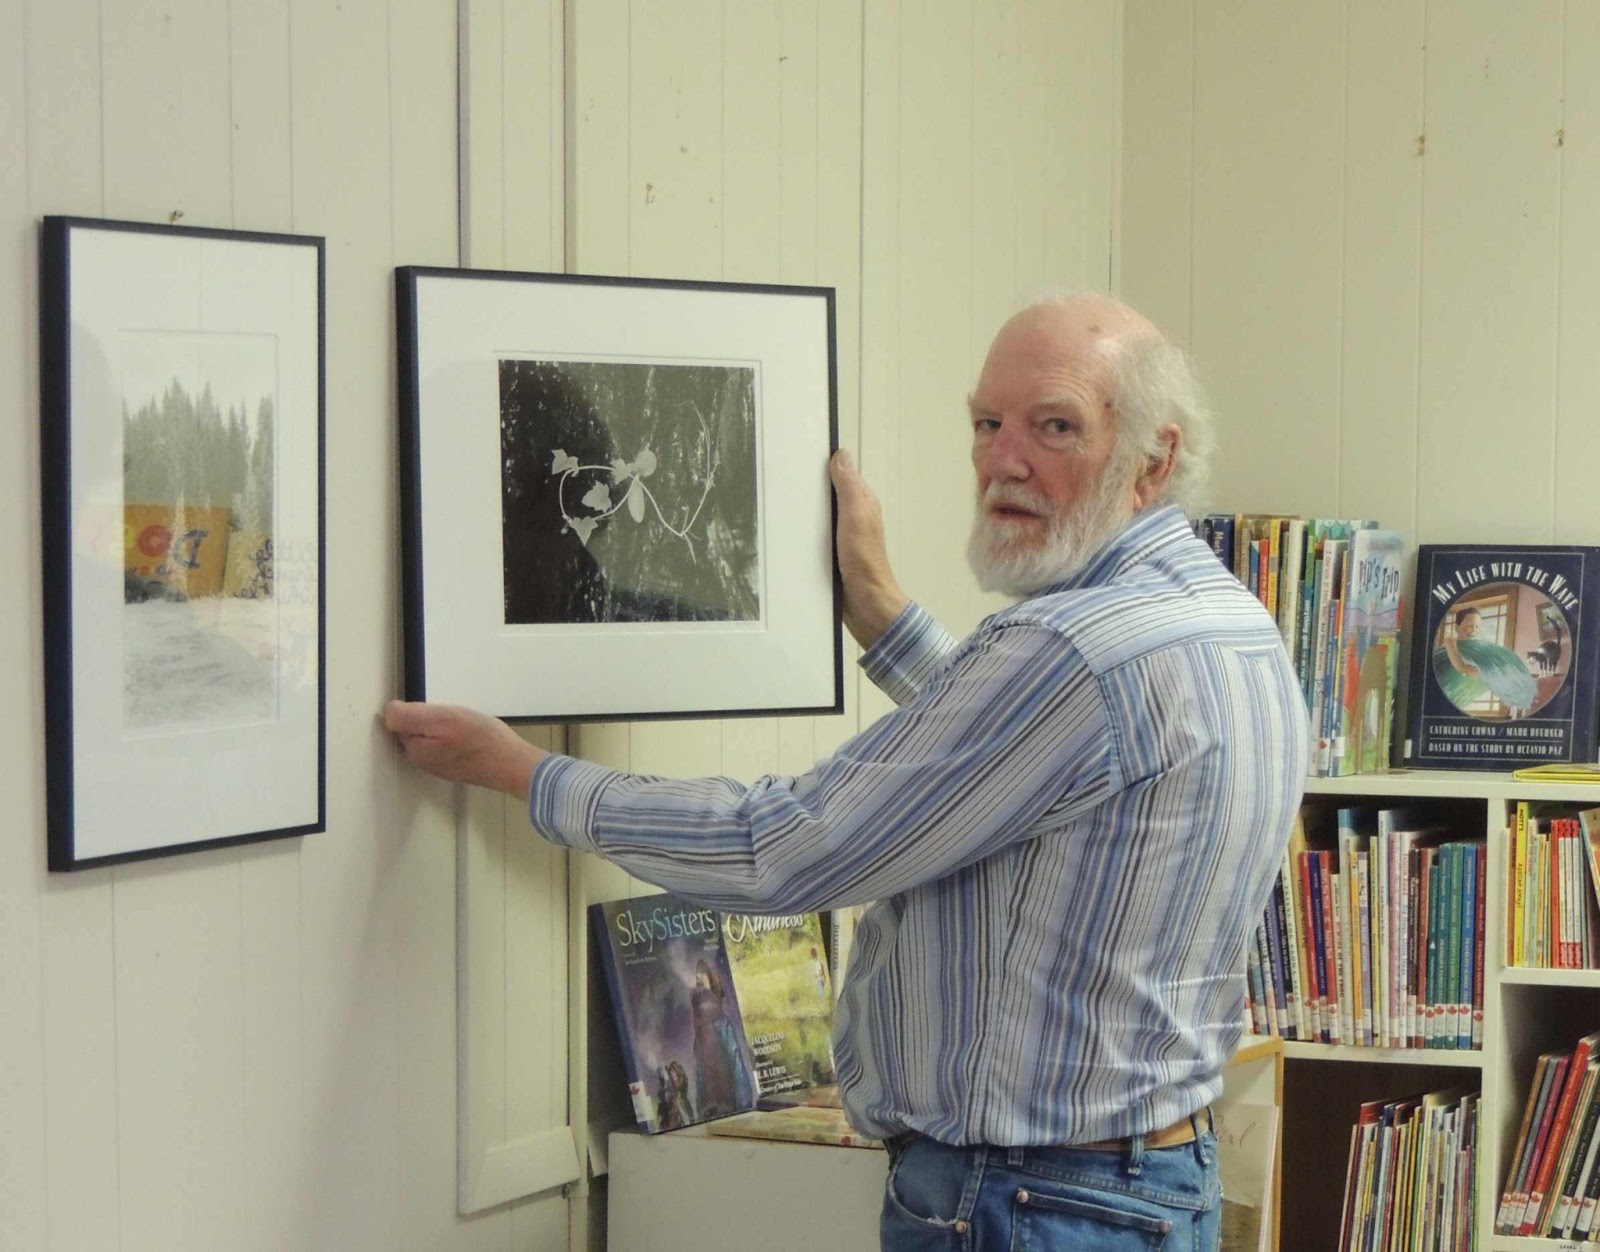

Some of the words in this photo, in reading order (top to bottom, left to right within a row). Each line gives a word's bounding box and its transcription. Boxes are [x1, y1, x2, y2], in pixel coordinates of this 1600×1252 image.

[1455, 565, 1487, 589] LIFE
[1490, 562, 1523, 578] WITH
[1526, 566, 1549, 587] THE
[1548, 574, 1579, 611] WAVE
[1429, 725, 1470, 736] CATHERINE
[1471, 726, 1497, 737] COWAN
[1506, 727, 1528, 737] MARK
[1428, 742, 1452, 752] BASED
[1453, 743, 1463, 753] ON
[1465, 743, 1479, 753] THE
[1481, 744, 1504, 754] STORY
[1505, 744, 1515, 754] BY
[1516, 745, 1547, 755] OCTAVIO
[1548, 745, 1563, 756] PAZ
